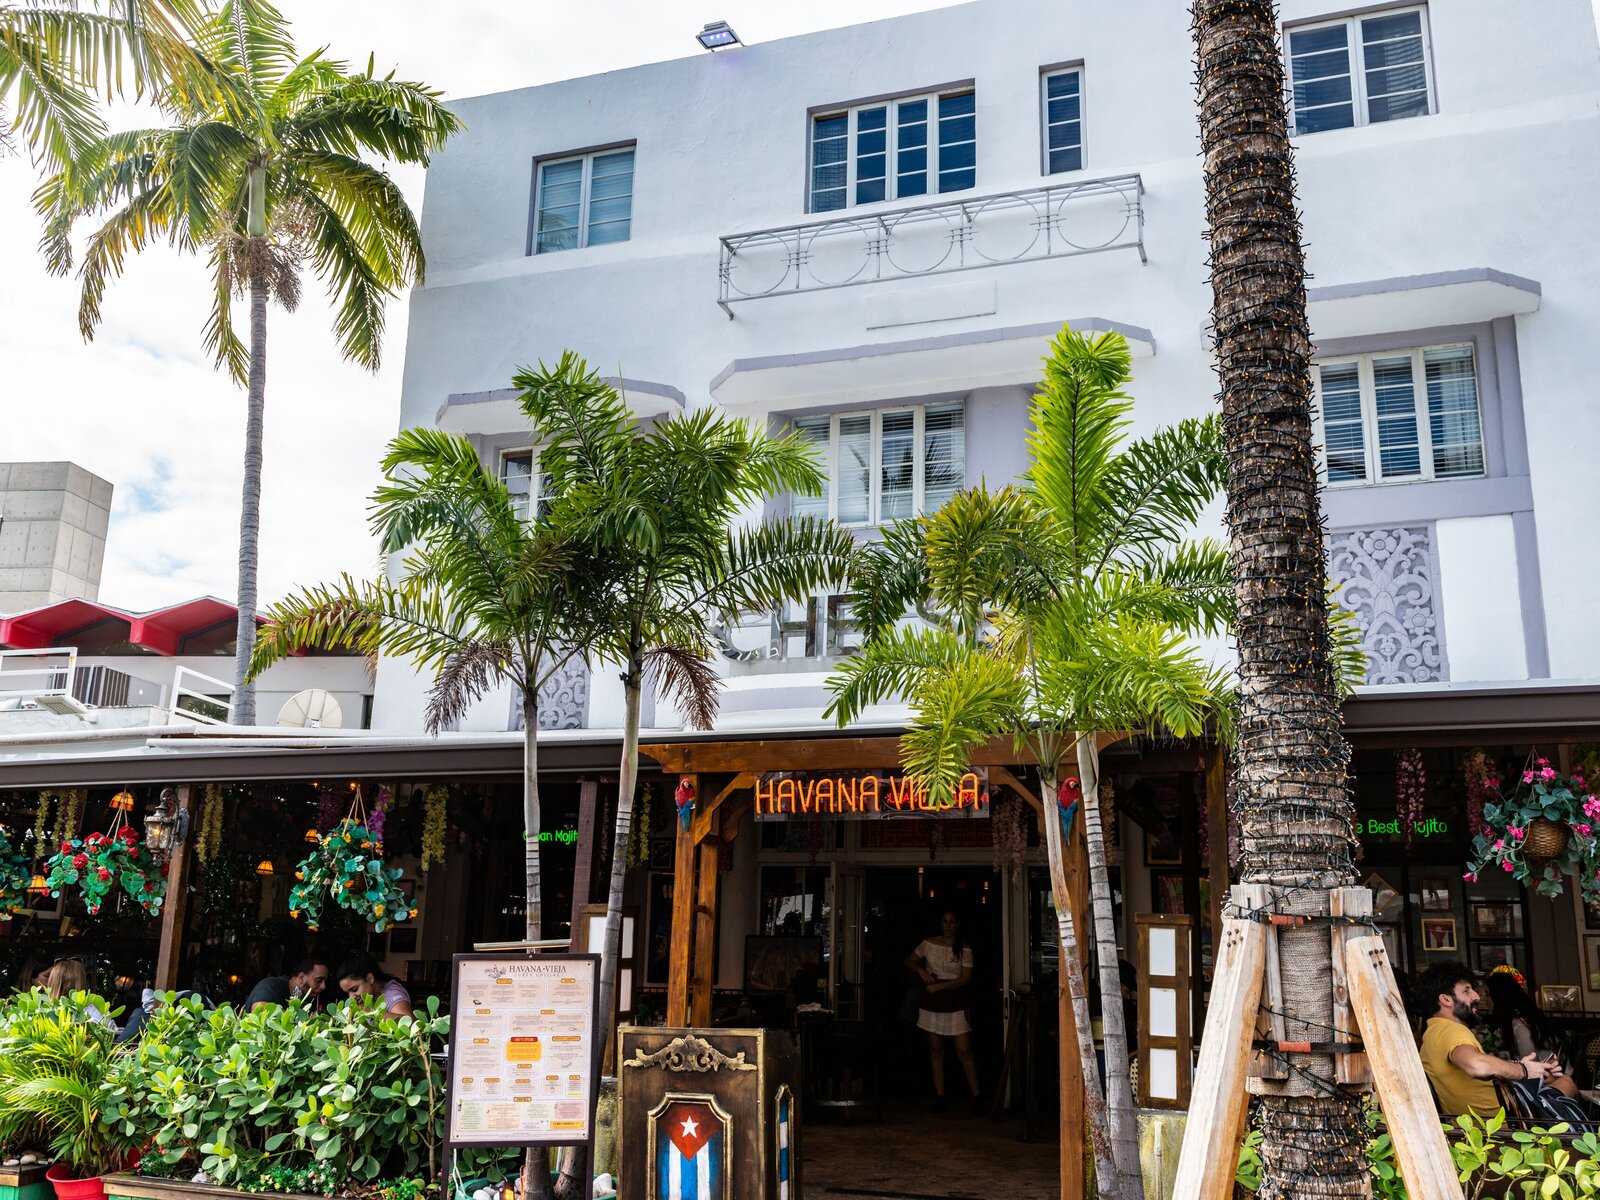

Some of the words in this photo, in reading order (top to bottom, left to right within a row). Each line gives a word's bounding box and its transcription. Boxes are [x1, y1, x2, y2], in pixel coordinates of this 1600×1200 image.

[756, 775, 880, 814] HAVANA
[1368, 819, 1401, 834] Best
[1410, 817, 1448, 838] ojito
[555, 829, 578, 845] Mojit
[509, 965, 542, 973] HAVANA
[545, 965, 567, 973] VIEJA
